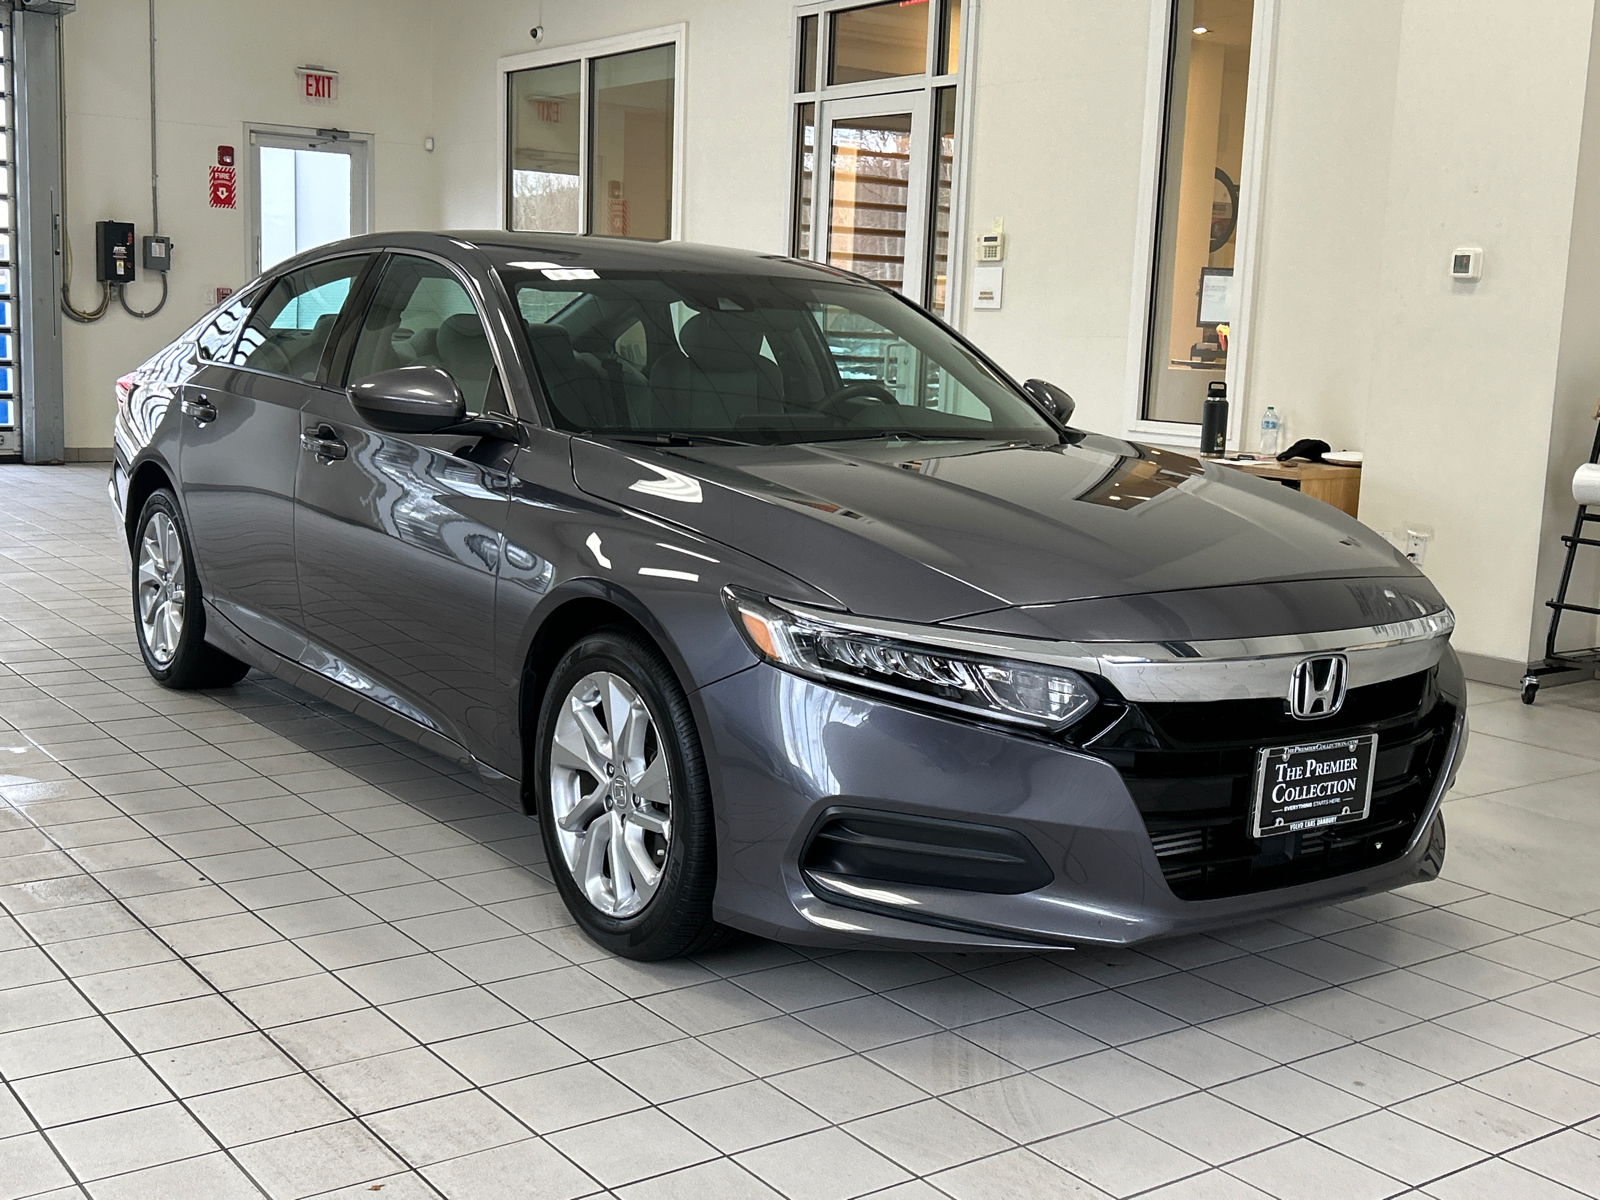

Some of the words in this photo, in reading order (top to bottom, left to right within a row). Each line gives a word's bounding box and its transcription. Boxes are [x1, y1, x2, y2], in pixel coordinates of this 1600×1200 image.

[305, 74, 333, 99] EXIT
[214, 172, 231, 180] FIRE
[1275, 763, 1304, 783] THE
[1304, 757, 1358, 778] PREMIER
[1271, 778, 1357, 803] COLLECTION
[1283, 802, 1313, 812] EVERYTHING
